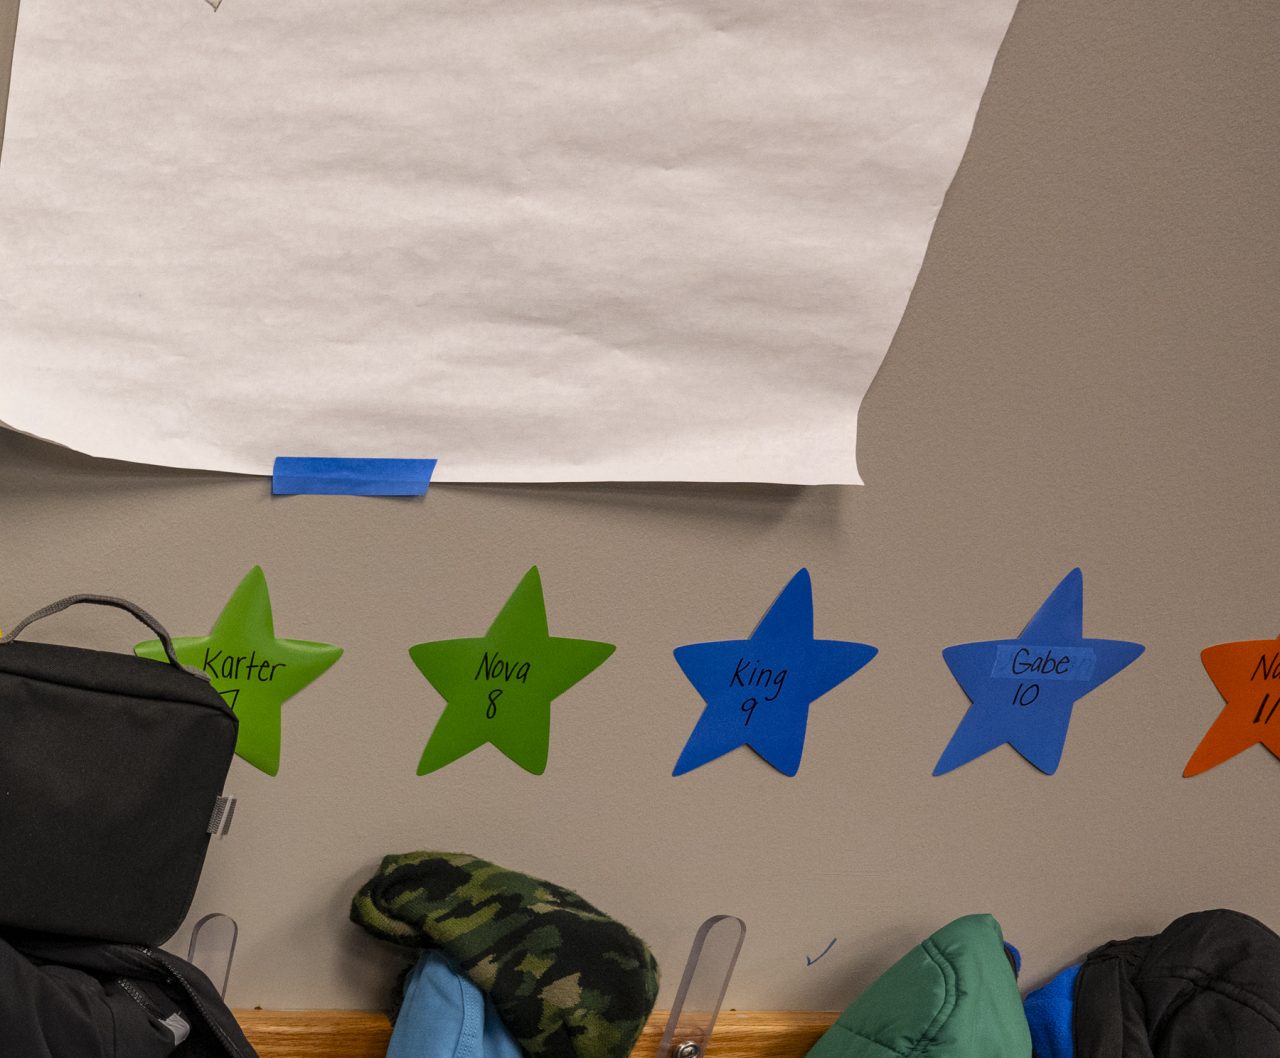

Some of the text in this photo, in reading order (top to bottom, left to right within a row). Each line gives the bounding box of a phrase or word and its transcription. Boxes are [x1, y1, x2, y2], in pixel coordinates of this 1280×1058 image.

[203, 647, 287, 682] Karter
[474, 652, 531, 683] Nova
[1012, 647, 1071, 675] Gabe
[729, 657, 788, 702] King
[218, 688, 240, 712] 7
[486, 688, 503, 720] 8
[1012, 683, 1040, 707] 10
[741, 697, 758, 727] 9
